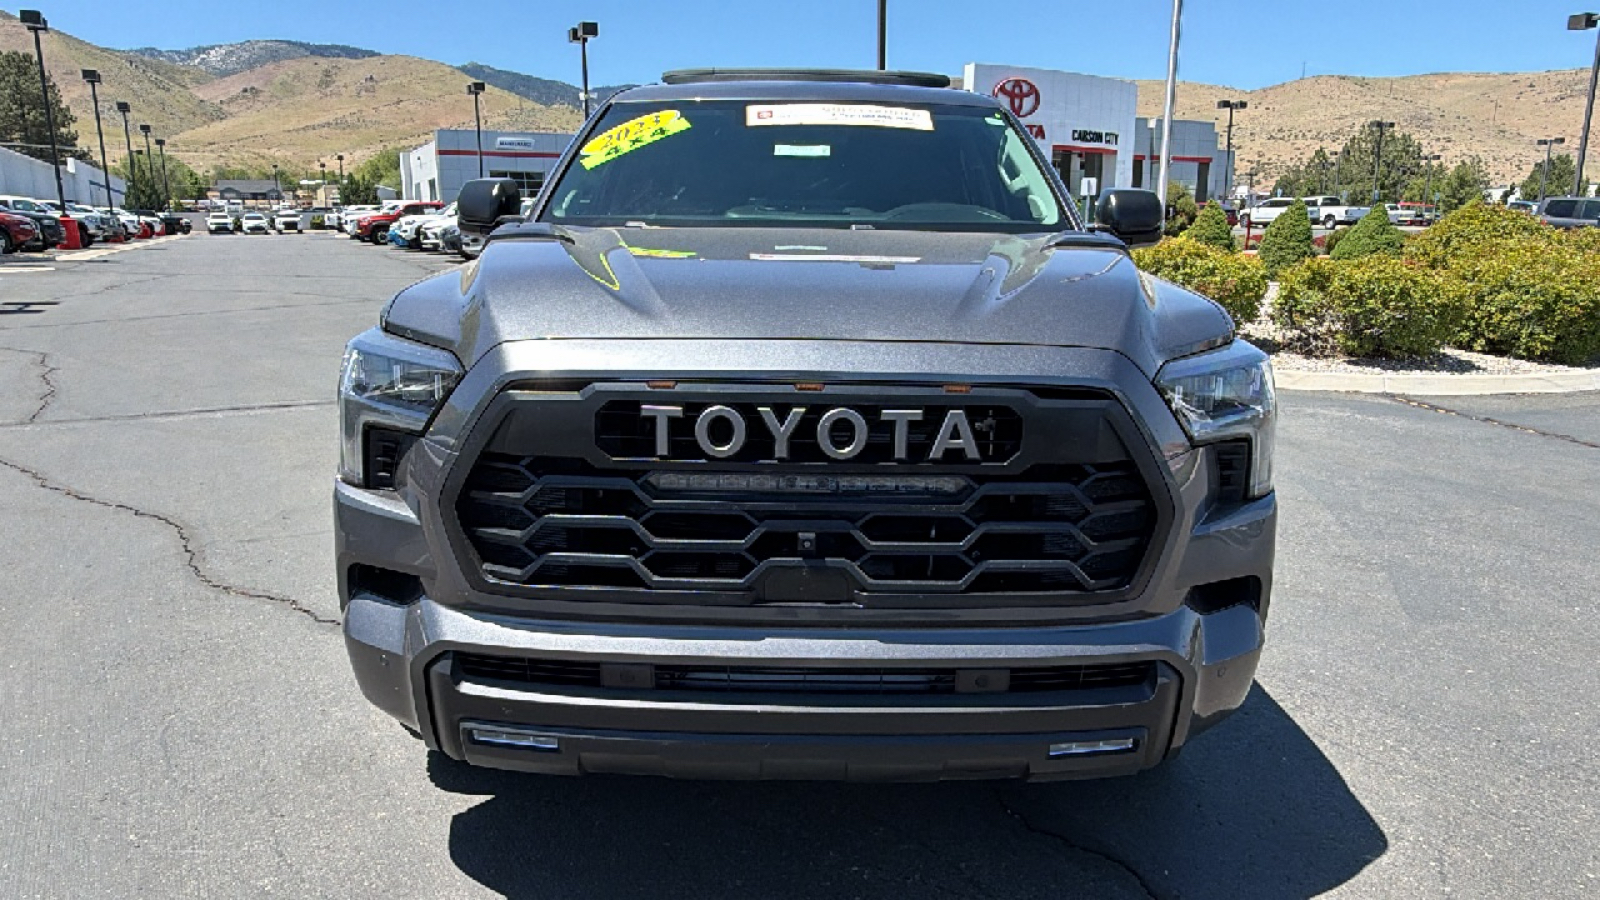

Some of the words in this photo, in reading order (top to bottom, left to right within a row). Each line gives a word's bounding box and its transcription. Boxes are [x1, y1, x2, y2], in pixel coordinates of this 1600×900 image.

[1071, 130, 1103, 143] CARSON
[1105, 132, 1119, 145] CITY
[640, 404, 981, 461] TOYOTA
